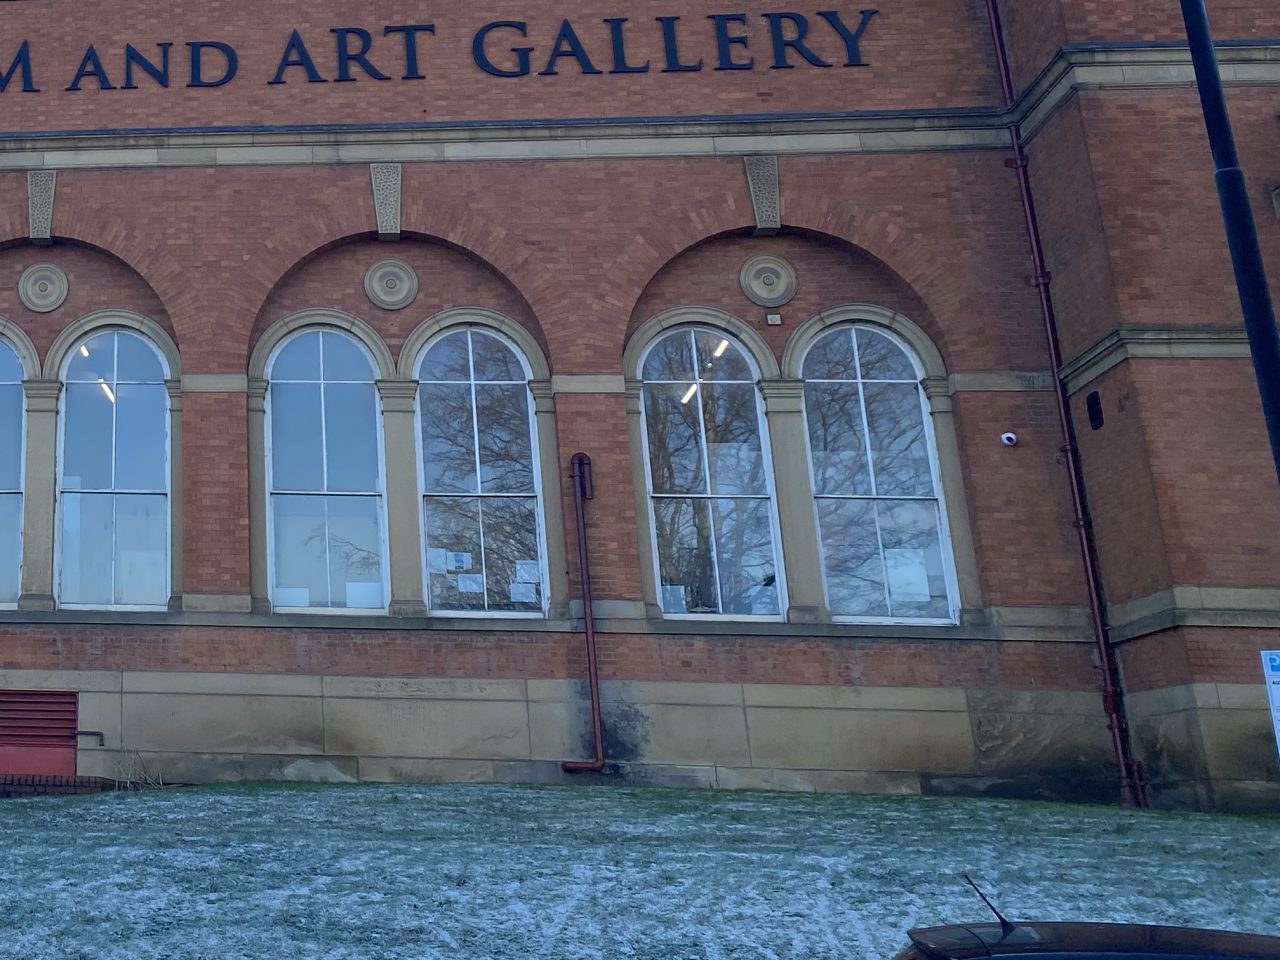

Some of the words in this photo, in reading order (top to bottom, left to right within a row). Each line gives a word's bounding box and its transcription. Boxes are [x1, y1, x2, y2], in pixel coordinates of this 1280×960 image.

[66, 40, 239, 92] AND
[267, 24, 436, 86] ART
[472, 9, 881, 79] GALLERY
